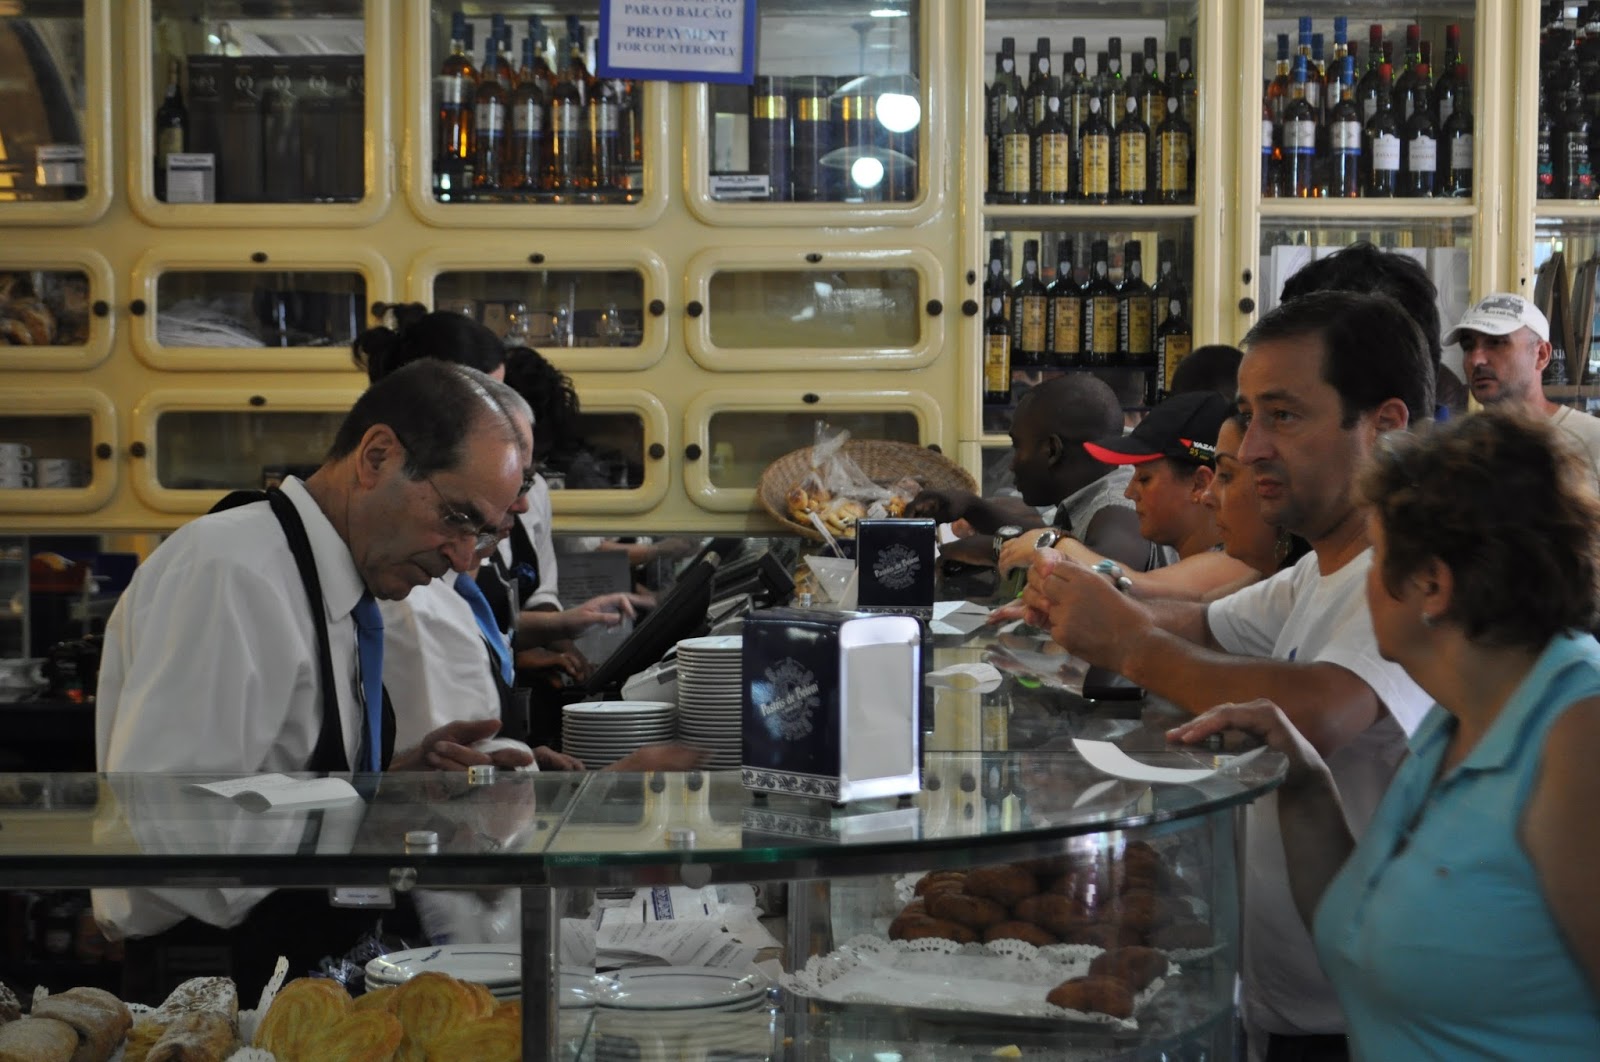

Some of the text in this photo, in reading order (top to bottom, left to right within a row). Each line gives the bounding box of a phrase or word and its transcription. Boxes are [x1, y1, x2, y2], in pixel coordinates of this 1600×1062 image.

[624, 4, 733, 19] PARA O BALCÃO
[626, 25, 728, 42] PREPAYMENT
[617, 41, 737, 56] FOR COUNTER ONLY
[1085, 298, 1093, 351] MADEIRA
[1157, 336, 1165, 390] MADEIRA
[786, 692, 795, 705] de
